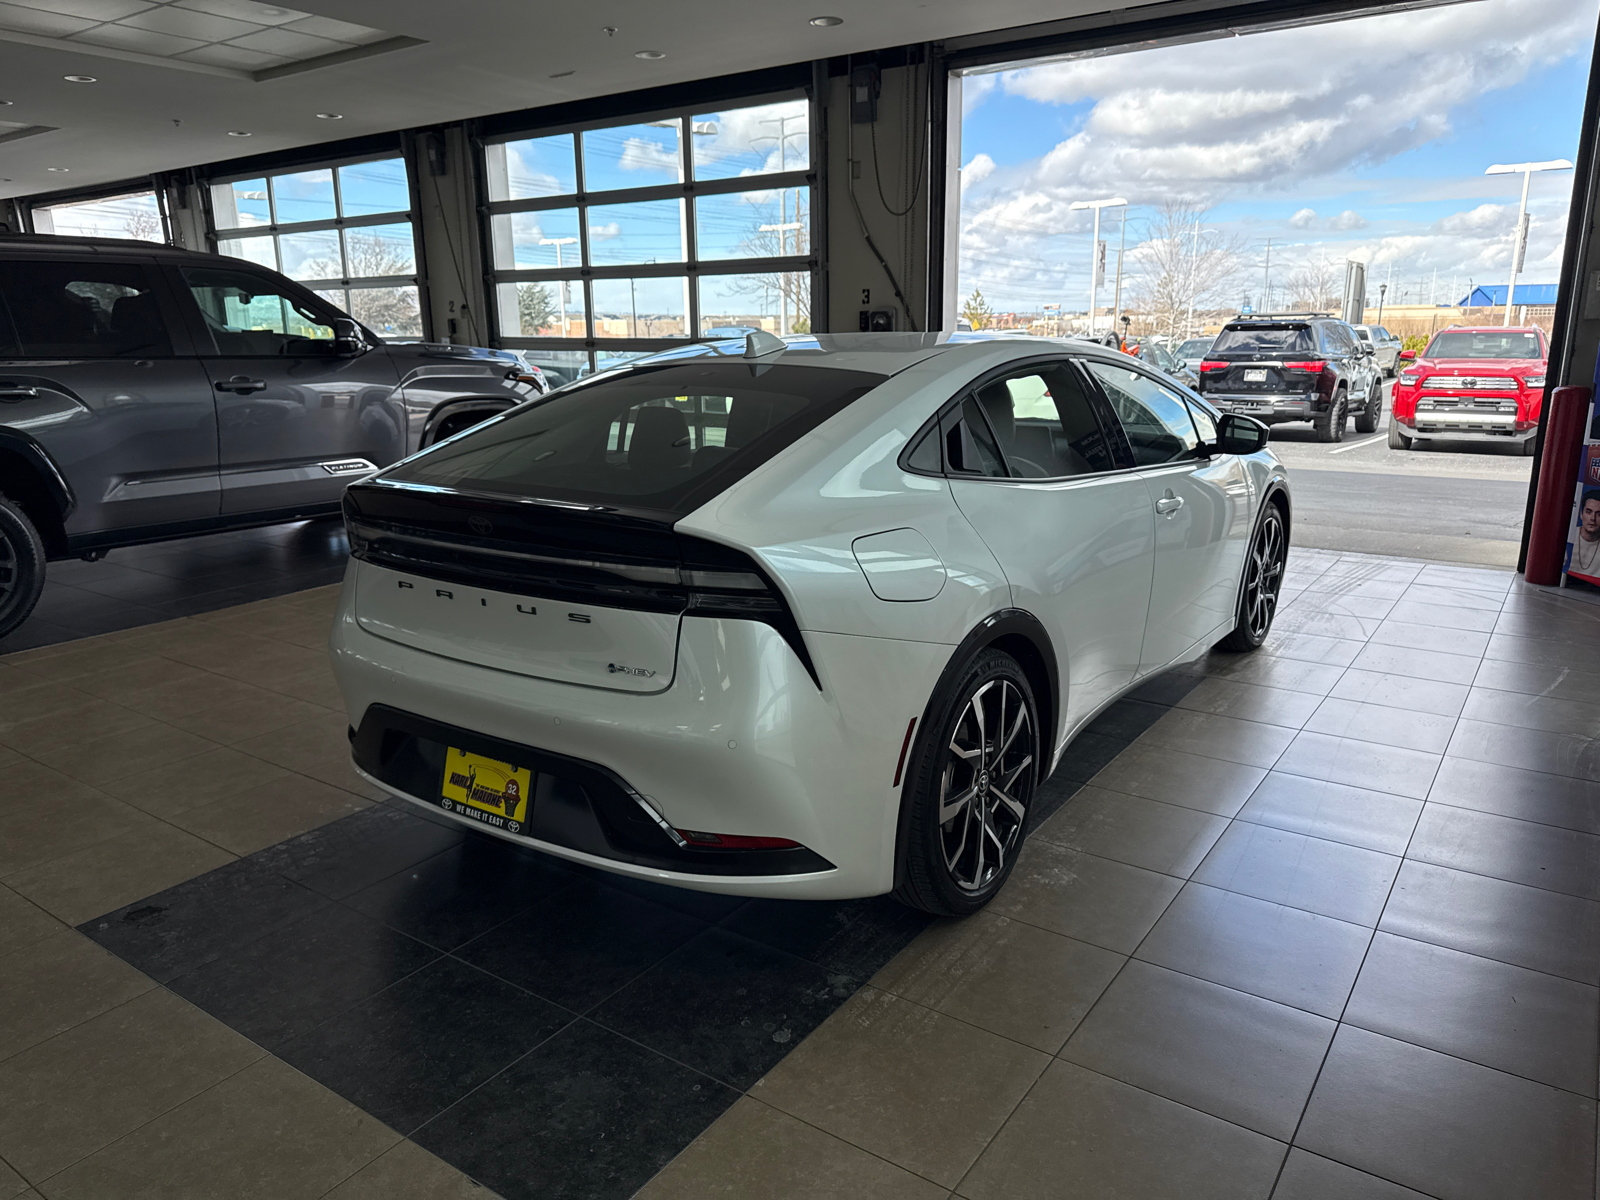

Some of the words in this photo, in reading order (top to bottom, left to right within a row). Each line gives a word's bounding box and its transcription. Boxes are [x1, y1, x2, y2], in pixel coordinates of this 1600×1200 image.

[862, 288, 870, 304] 3
[448, 300, 455, 313] 2
[398, 580, 591, 624] PRIUS
[470, 787, 503, 809] MALONE
[507, 784, 517, 795] 32
[456, 803, 465, 814] WE
[465, 807, 481, 820] MAKE
[482, 812, 488, 822] IT
[489, 815, 504, 827] EASY
